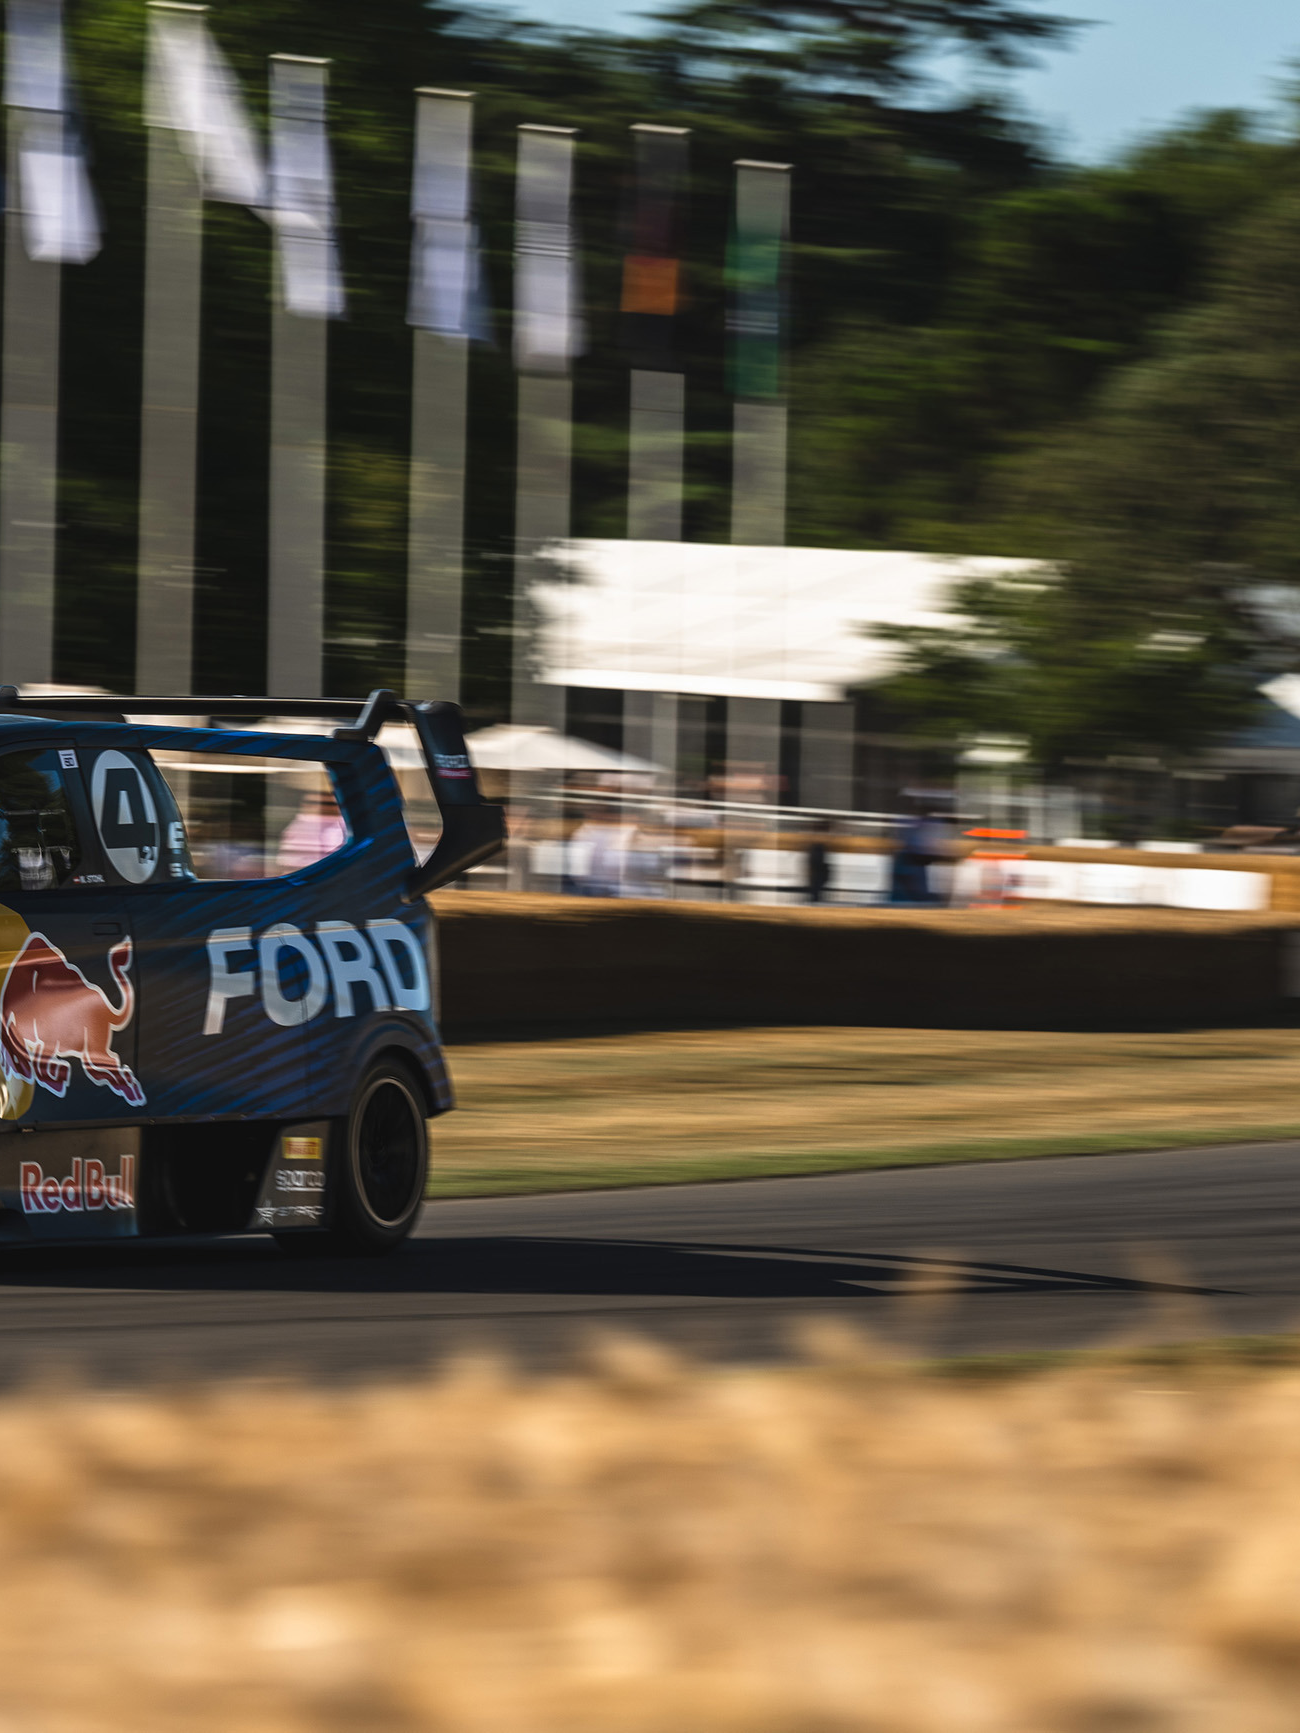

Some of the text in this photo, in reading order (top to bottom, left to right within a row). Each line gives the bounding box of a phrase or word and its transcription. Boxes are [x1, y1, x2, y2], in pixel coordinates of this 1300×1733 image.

[202, 918, 431, 1036] FORD
[20, 1157, 84, 1213] Red
[84, 1154, 135, 1211] Bull
